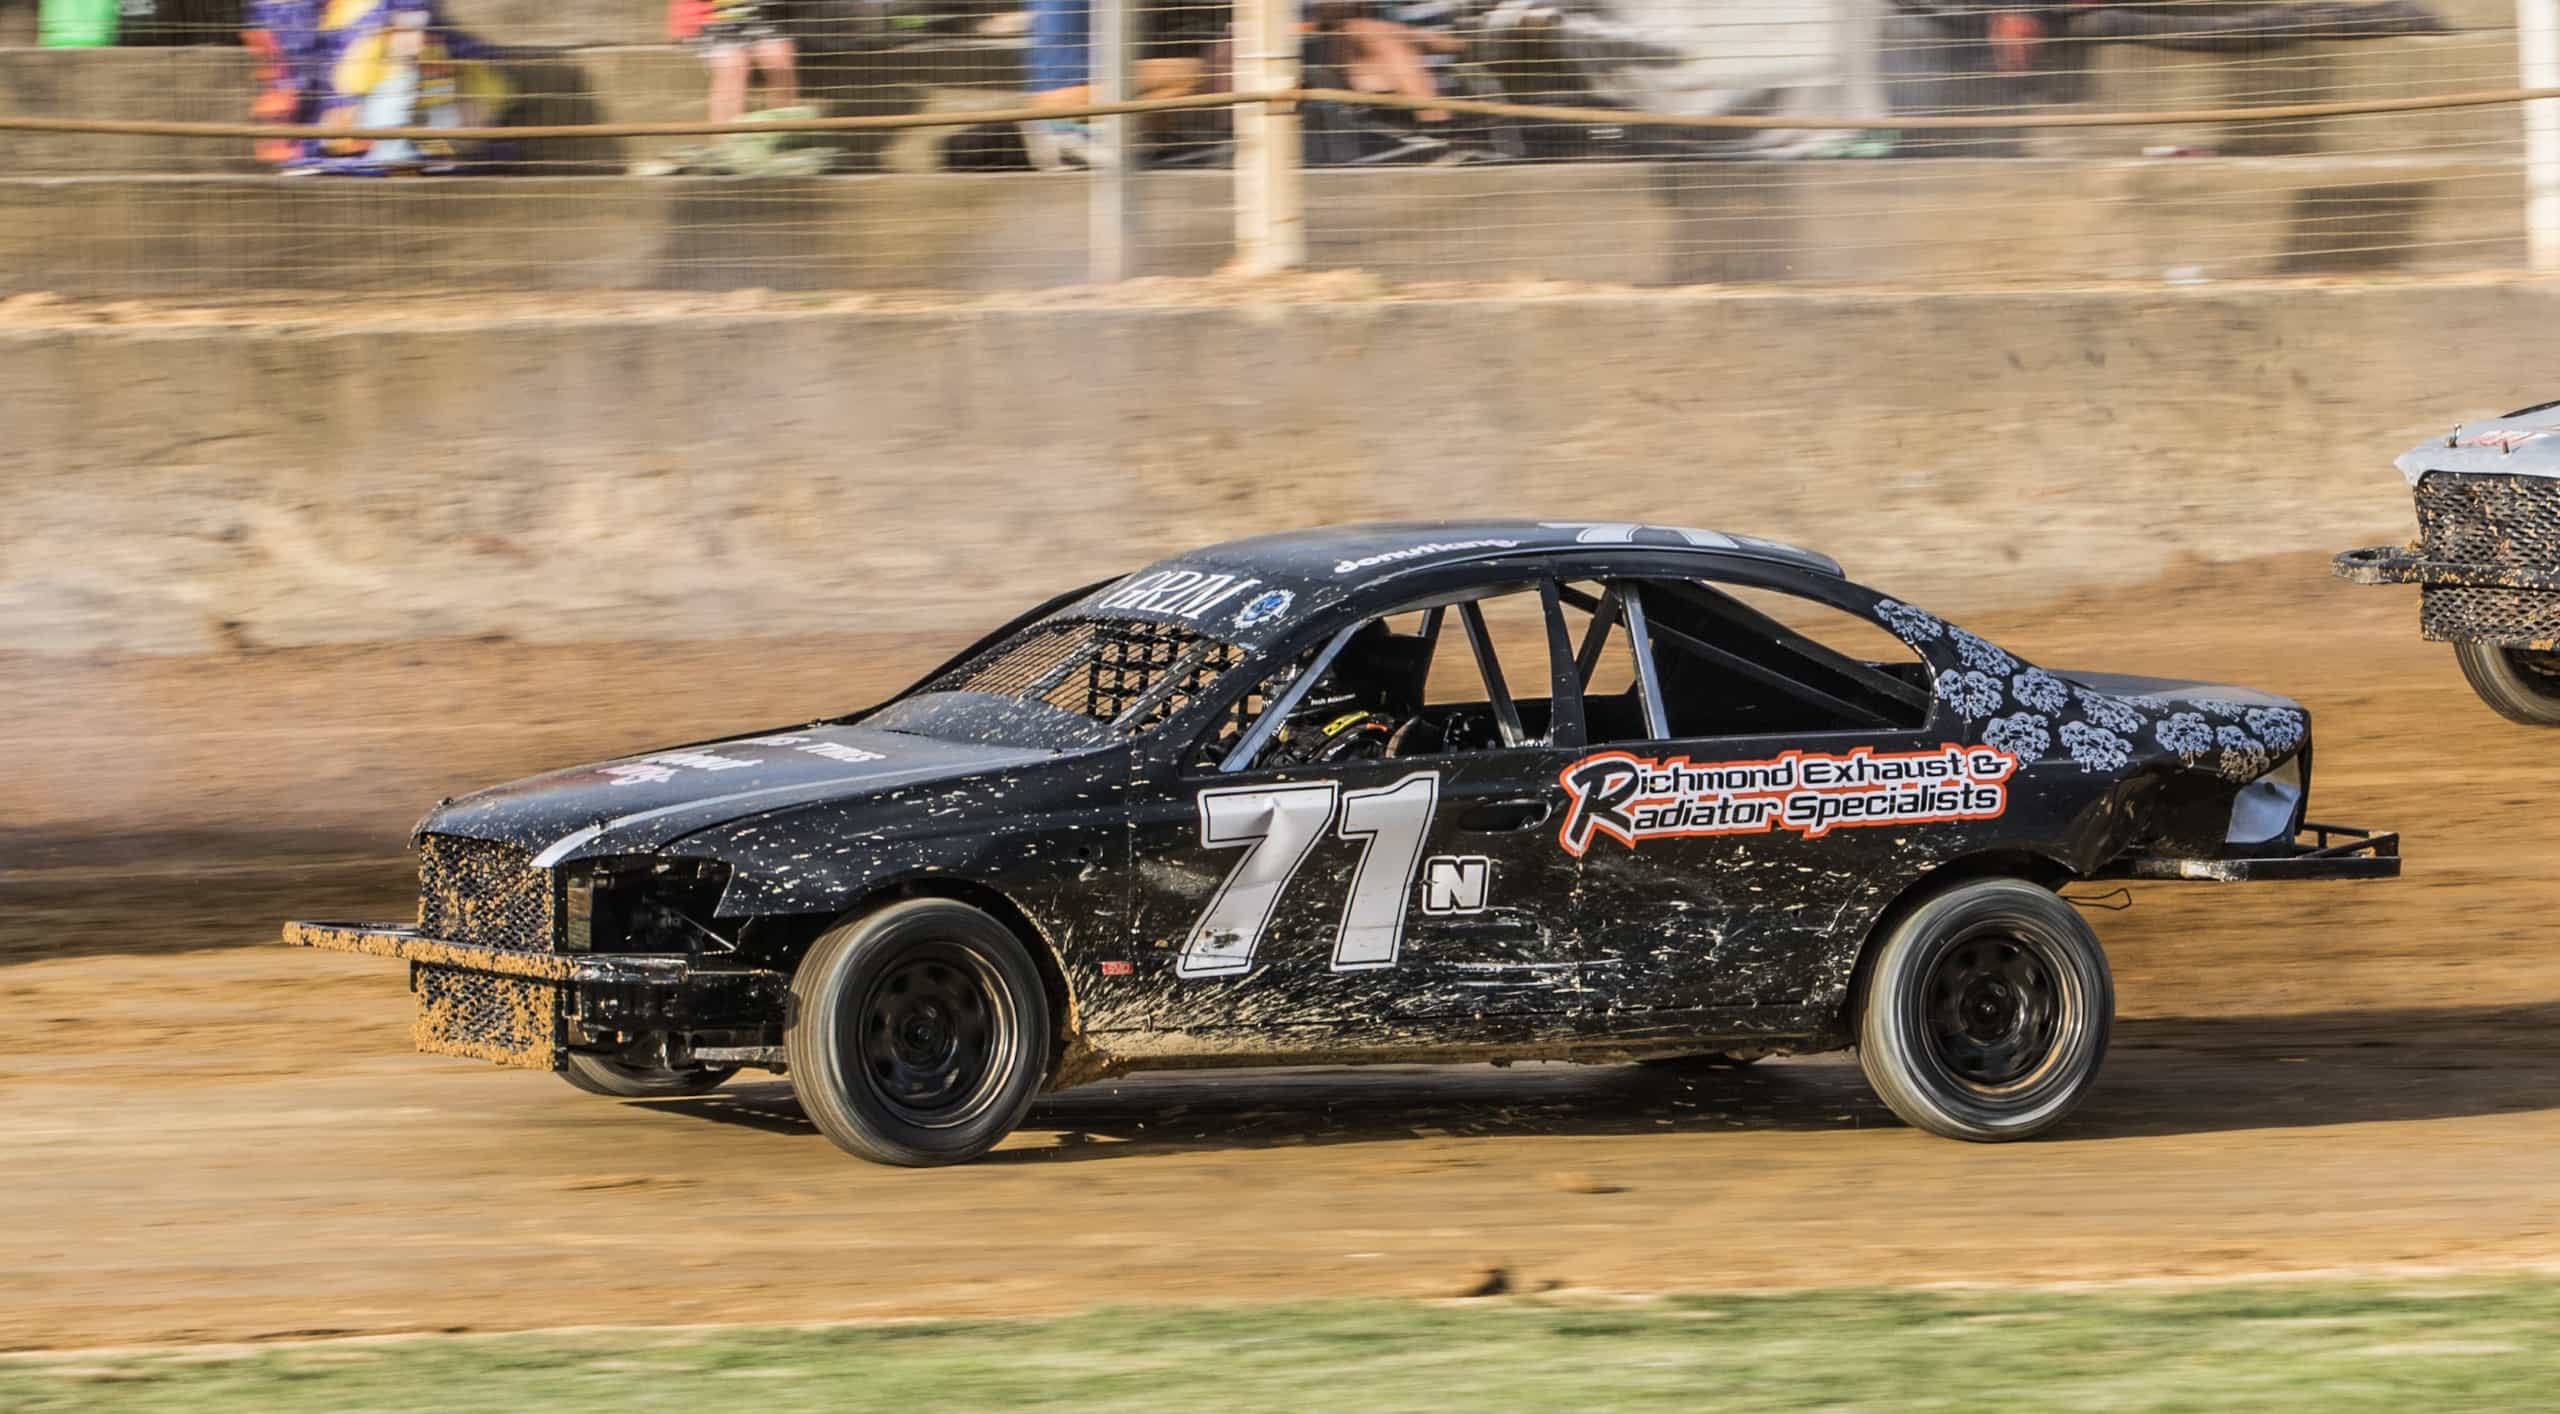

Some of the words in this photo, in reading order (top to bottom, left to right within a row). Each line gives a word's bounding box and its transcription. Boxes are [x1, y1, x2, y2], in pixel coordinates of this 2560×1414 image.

[1571, 760, 1793, 843] Richmond
[1803, 752, 1963, 785] Exhaust
[1973, 754, 2009, 775] &
[1787, 783, 1998, 827] Specialists
[1176, 771, 1440, 978] 71
[1422, 855, 1491, 915] N
